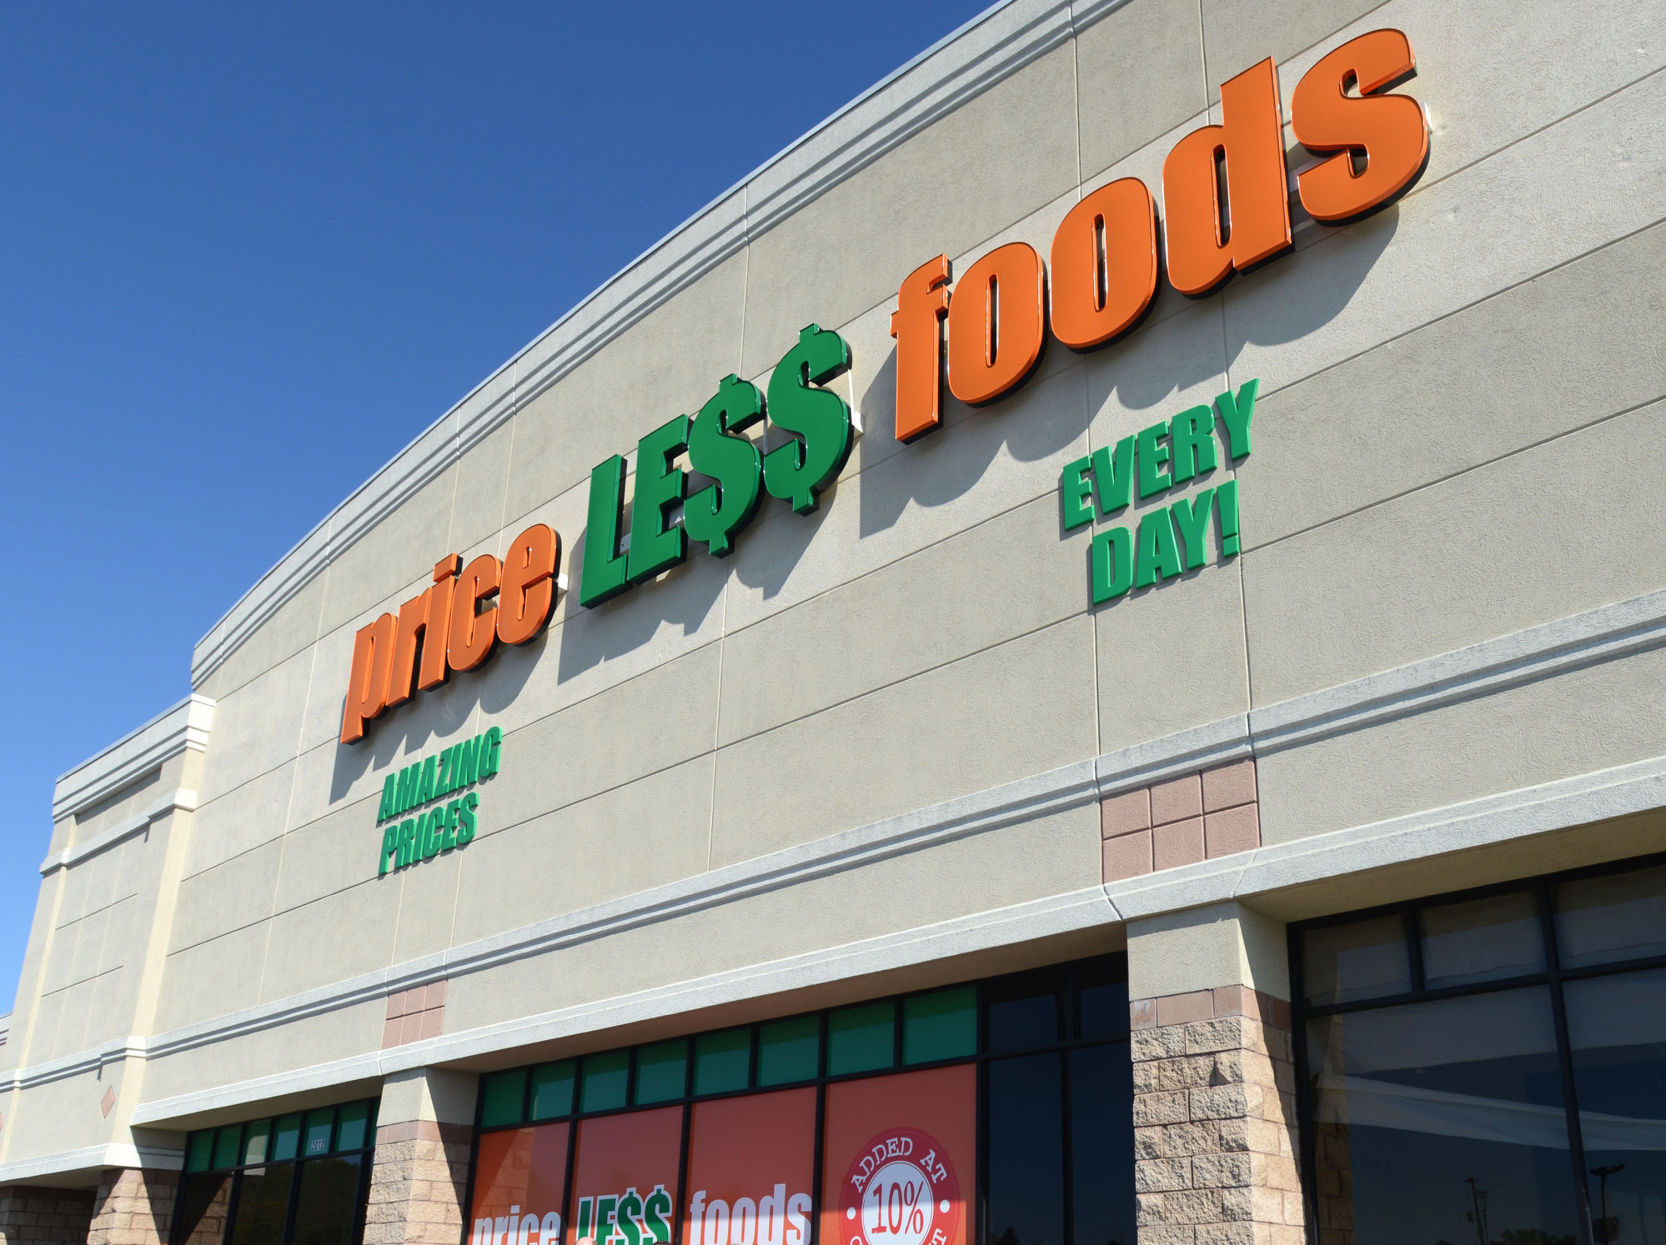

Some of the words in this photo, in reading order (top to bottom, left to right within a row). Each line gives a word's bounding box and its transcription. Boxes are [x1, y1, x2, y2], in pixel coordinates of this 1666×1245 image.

[340, 523, 558, 743] price
[891, 28, 1429, 444] foods
[1063, 378, 1259, 531] EVERY
[1091, 479, 1239, 605] DAY!
[377, 726, 503, 822] AMAZING
[379, 792, 479, 875] PRICES
[851, 1137, 913, 1193] ADDED
[920, 1149, 948, 1183] AT
[872, 1180, 924, 1235] 10%
[689, 1183, 812, 1244] foods
